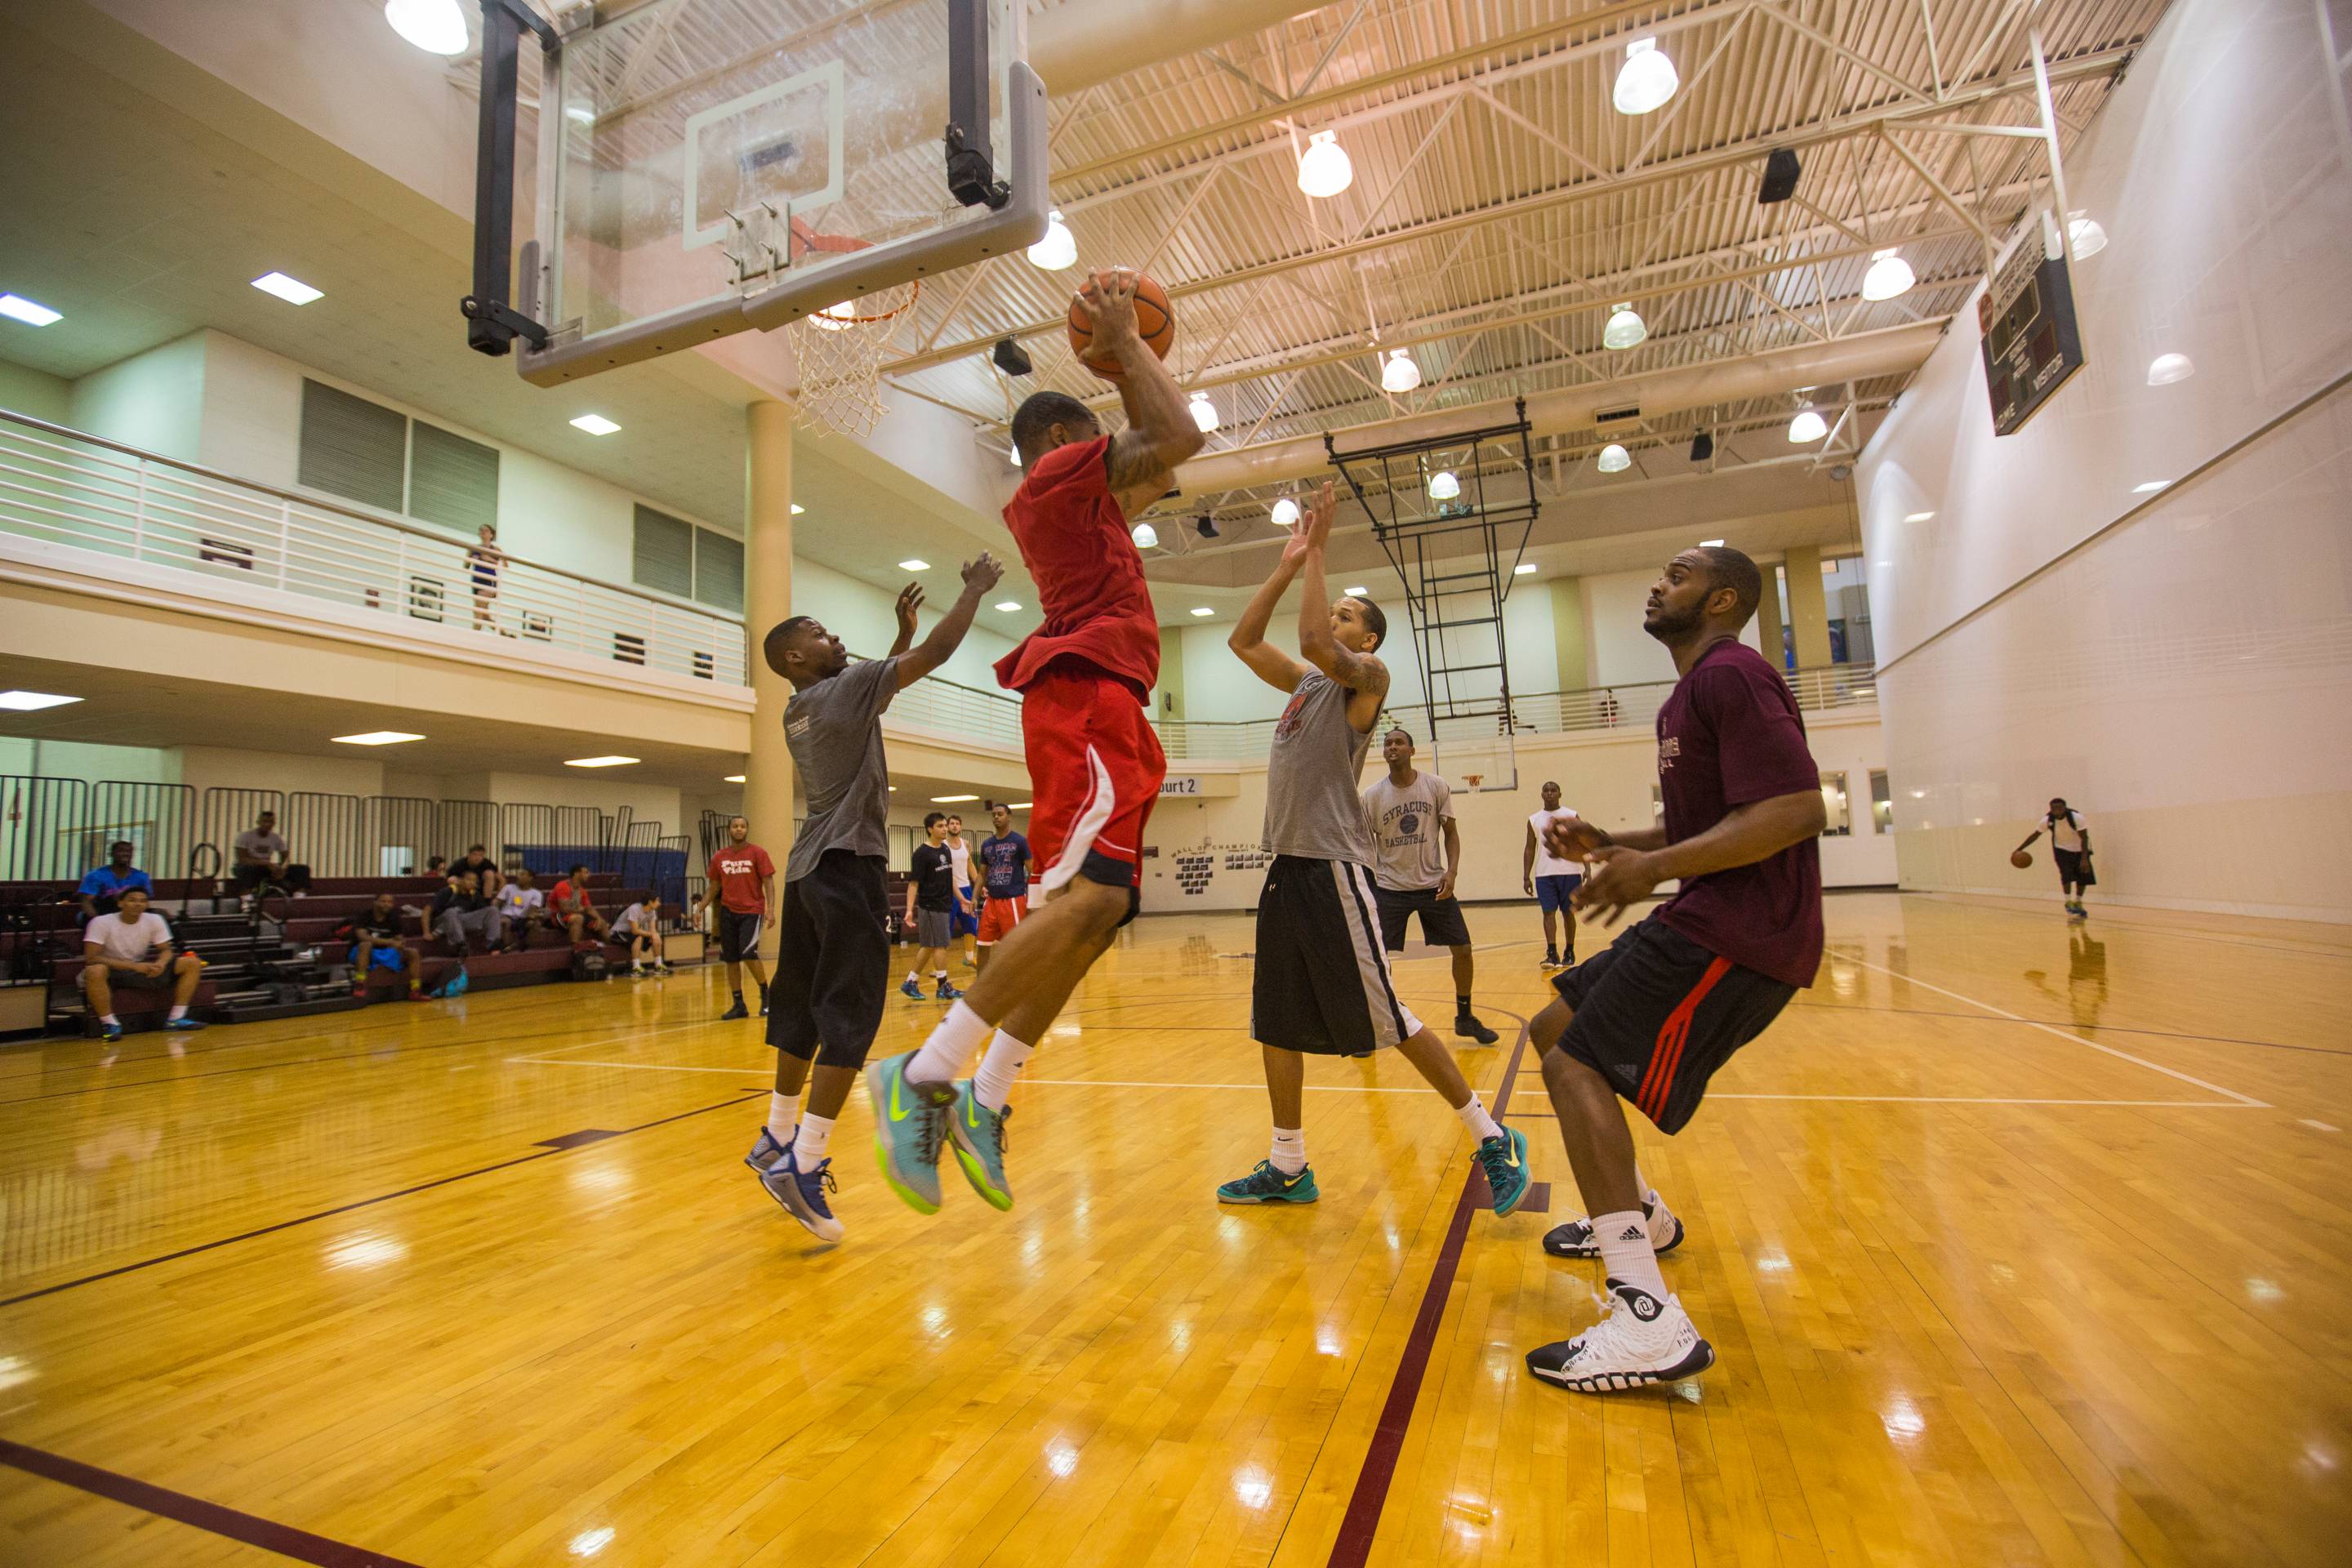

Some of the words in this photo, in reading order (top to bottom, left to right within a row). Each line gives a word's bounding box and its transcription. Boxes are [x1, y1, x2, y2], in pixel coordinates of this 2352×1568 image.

[2034, 352, 2064, 391] VISITOR
[1160, 780, 1184, 792] ourt
[1187, 778, 1195, 792] 2
[1170, 846, 1192, 858] WALL
[721, 860, 753, 868] Pura
[722, 866, 751, 875] Vida
